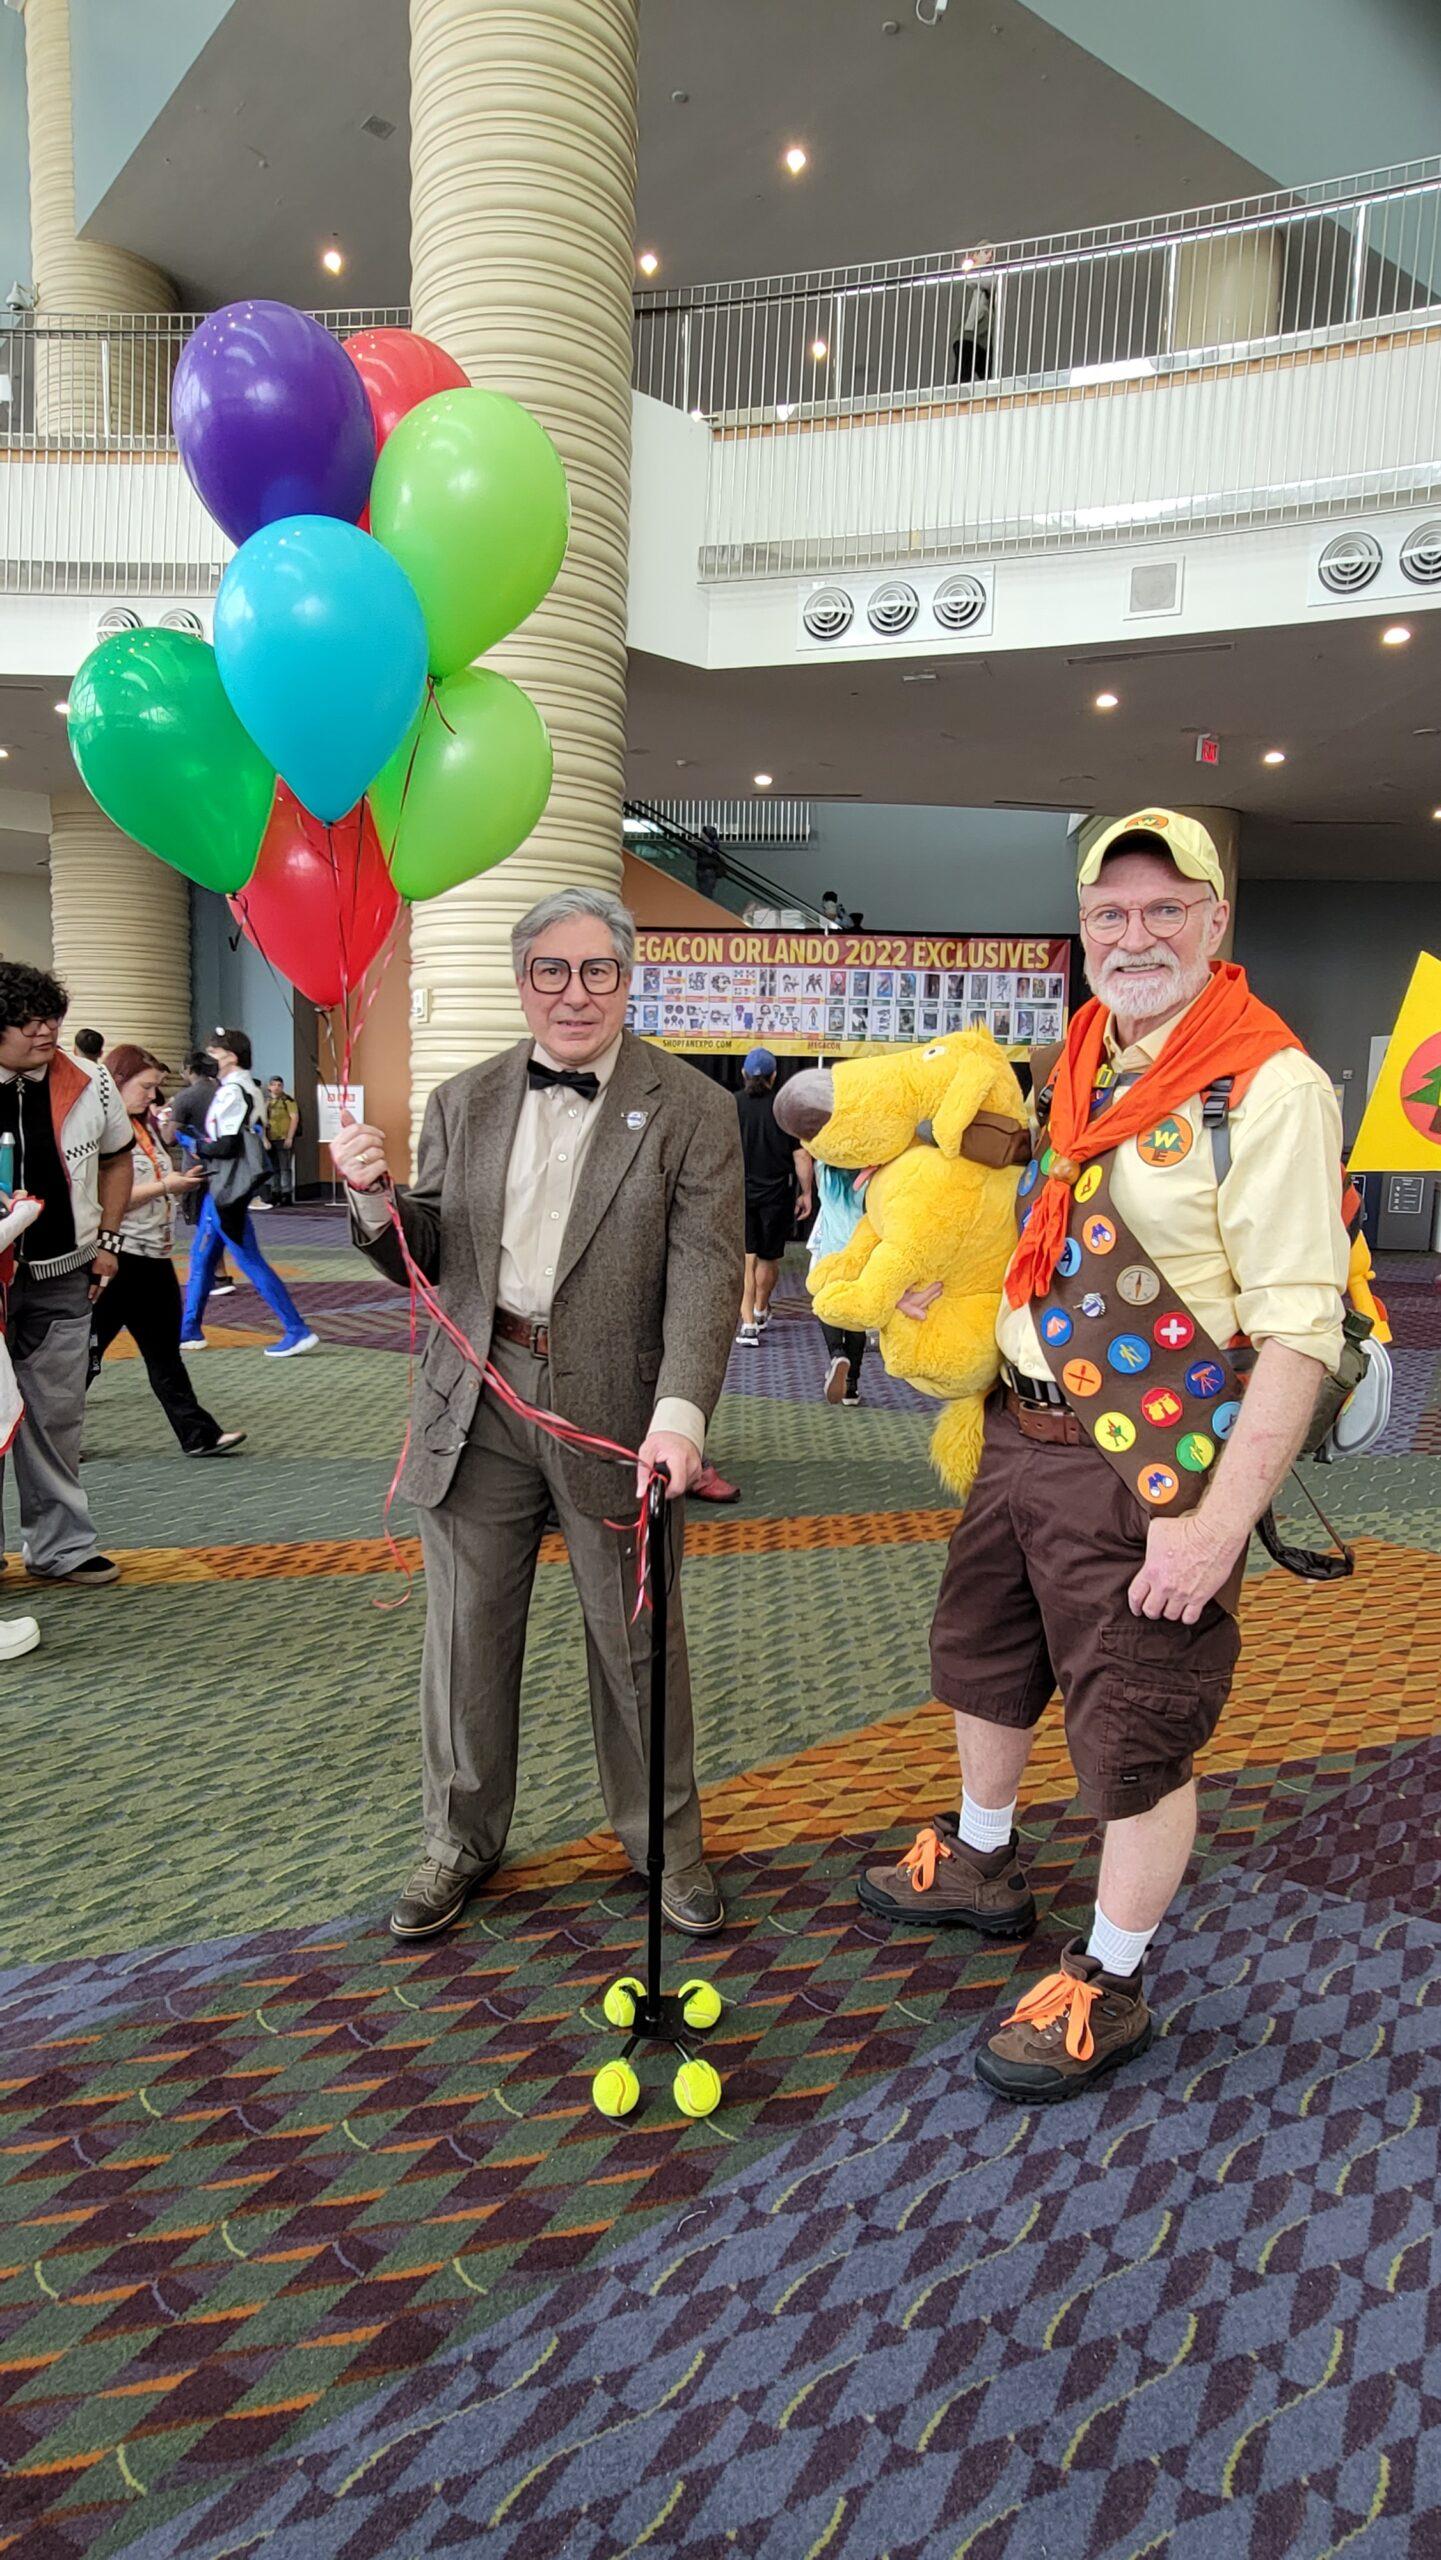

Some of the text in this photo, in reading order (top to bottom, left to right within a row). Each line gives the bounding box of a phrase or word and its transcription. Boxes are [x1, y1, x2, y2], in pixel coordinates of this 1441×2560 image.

[634, 936, 1050, 969] EGACON ORLANDO 2022 EXCLUSIVES
[662, 1039, 732, 1049] SHOPFANEXPO.COM
[807, 1041, 841, 1051] MEGACON
[1154, 1130, 1179, 1149] W
